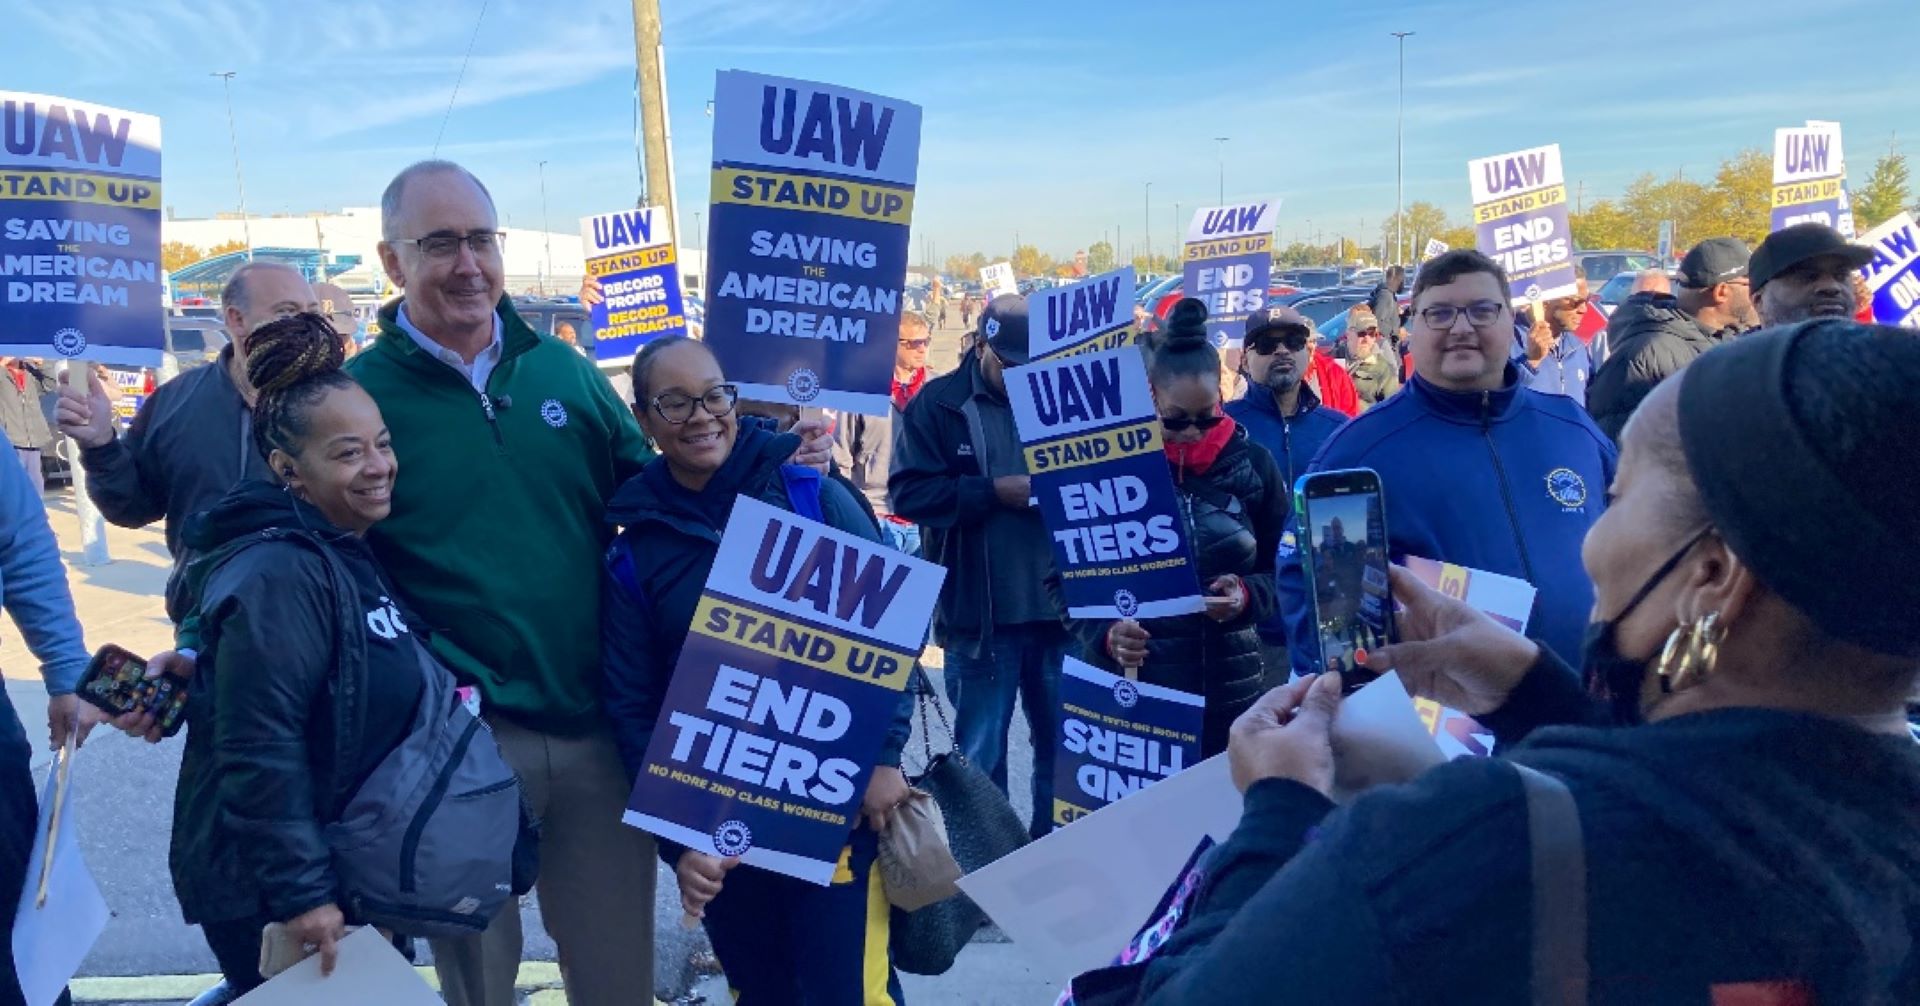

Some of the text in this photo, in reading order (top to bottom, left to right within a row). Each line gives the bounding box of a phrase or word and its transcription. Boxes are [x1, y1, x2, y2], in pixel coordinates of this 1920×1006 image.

[5, 100, 131, 167] UAW
[760, 85, 895, 172] UAW
[1484, 152, 1546, 194] UAW
[1785, 134, 1831, 174] UAW
[0, 175, 151, 204] TAND UP
[731, 175, 904, 217] STAND UP
[1480, 190, 1561, 221] STAND UP
[1776, 182, 1838, 205] STAND UP
[4, 218, 130, 246] SAVING
[593, 209, 652, 249] UAW
[1202, 203, 1268, 235] UAW
[1494, 216, 1554, 250] END
[56, 243, 81, 253] THE
[590, 250, 669, 276] STAND UP
[750, 230, 877, 269] SAVING
[1189, 238, 1267, 259] STAND UP
[1489, 238, 1569, 274] TIERS
[0, 255, 156, 283] MERICAN
[603, 275, 664, 297] RECORD
[802, 265, 825, 278] THE
[1197, 263, 1254, 292] END
[8, 281, 129, 307] DREAM
[606, 288, 667, 310] PROFITS
[717, 271, 898, 315] AMERICAN
[1047, 276, 1121, 342] UAW
[596, 315, 684, 340] CONTRACTS
[608, 304, 669, 326] RECORD
[746, 308, 867, 344] DREAM
[1027, 356, 1122, 427] UAW
[1033, 429, 1153, 469] STAND UP
[1059, 475, 1149, 522] END
[1053, 514, 1180, 564] TIERS
[751, 518, 912, 630] UAW
[705, 606, 899, 680] STAND UP
[706, 663, 852, 742] END
[669, 710, 861, 806] TIERS
[1062, 718, 1183, 776] TIERS
[648, 763, 847, 826] NO MORE 2ND CLASS WORKERS
[1076, 764, 1155, 802] ND
